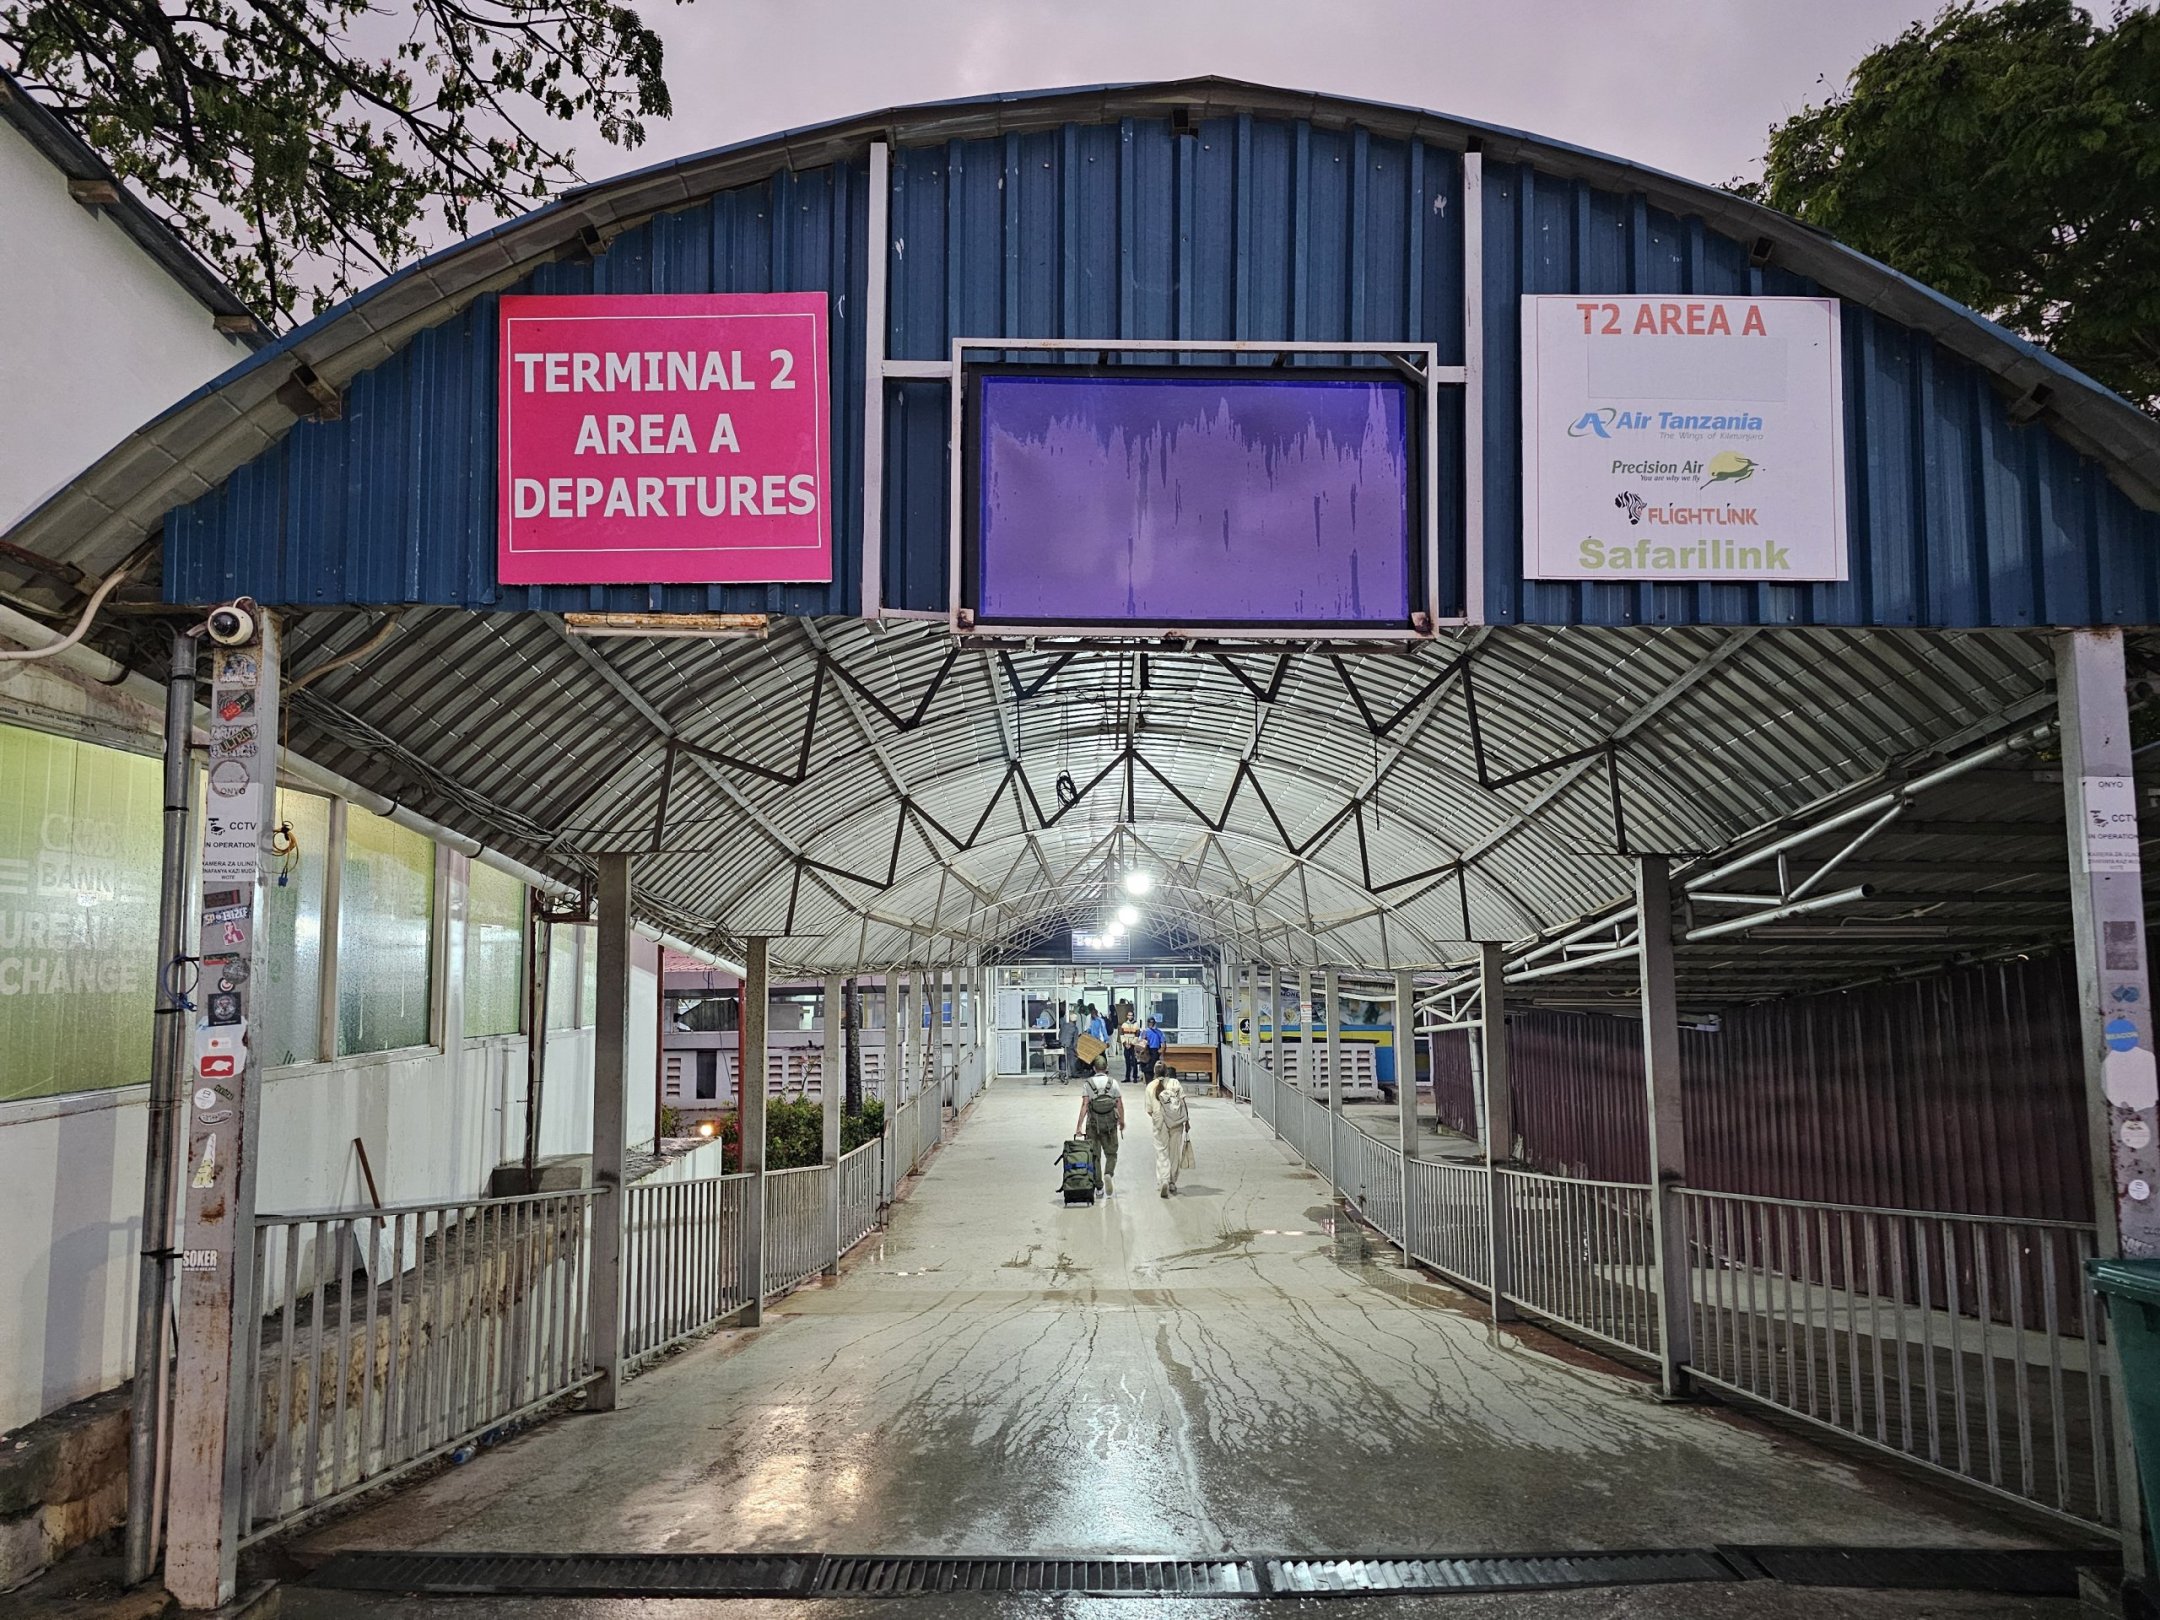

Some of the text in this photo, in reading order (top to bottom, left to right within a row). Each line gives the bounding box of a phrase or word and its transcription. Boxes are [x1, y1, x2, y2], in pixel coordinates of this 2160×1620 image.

[1576, 303, 1767, 337] T2 AREA A
[514, 349, 796, 393] TERMINAL 2
[1616, 411, 1763, 431] Air Tanzania
[574, 412, 741, 455] AREA A
[1659, 432, 1675, 440] The
[1679, 431, 1703, 442] Wings
[1707, 431, 1716, 440] of
[1611, 460, 1704, 474] Precision Air
[1666, 475, 1680, 483] why
[1692, 475, 1701, 483] fly
[514, 473, 816, 519] DEPARTURES
[1578, 538, 1791, 570] Safarilink
[220, 786, 246, 796] ONYO
[229, 821, 257, 831] CCTV
[213, 841, 256, 849] OPERATION
[41, 861, 114, 893] BANK
[183, 1250, 218, 1267] SOKER
